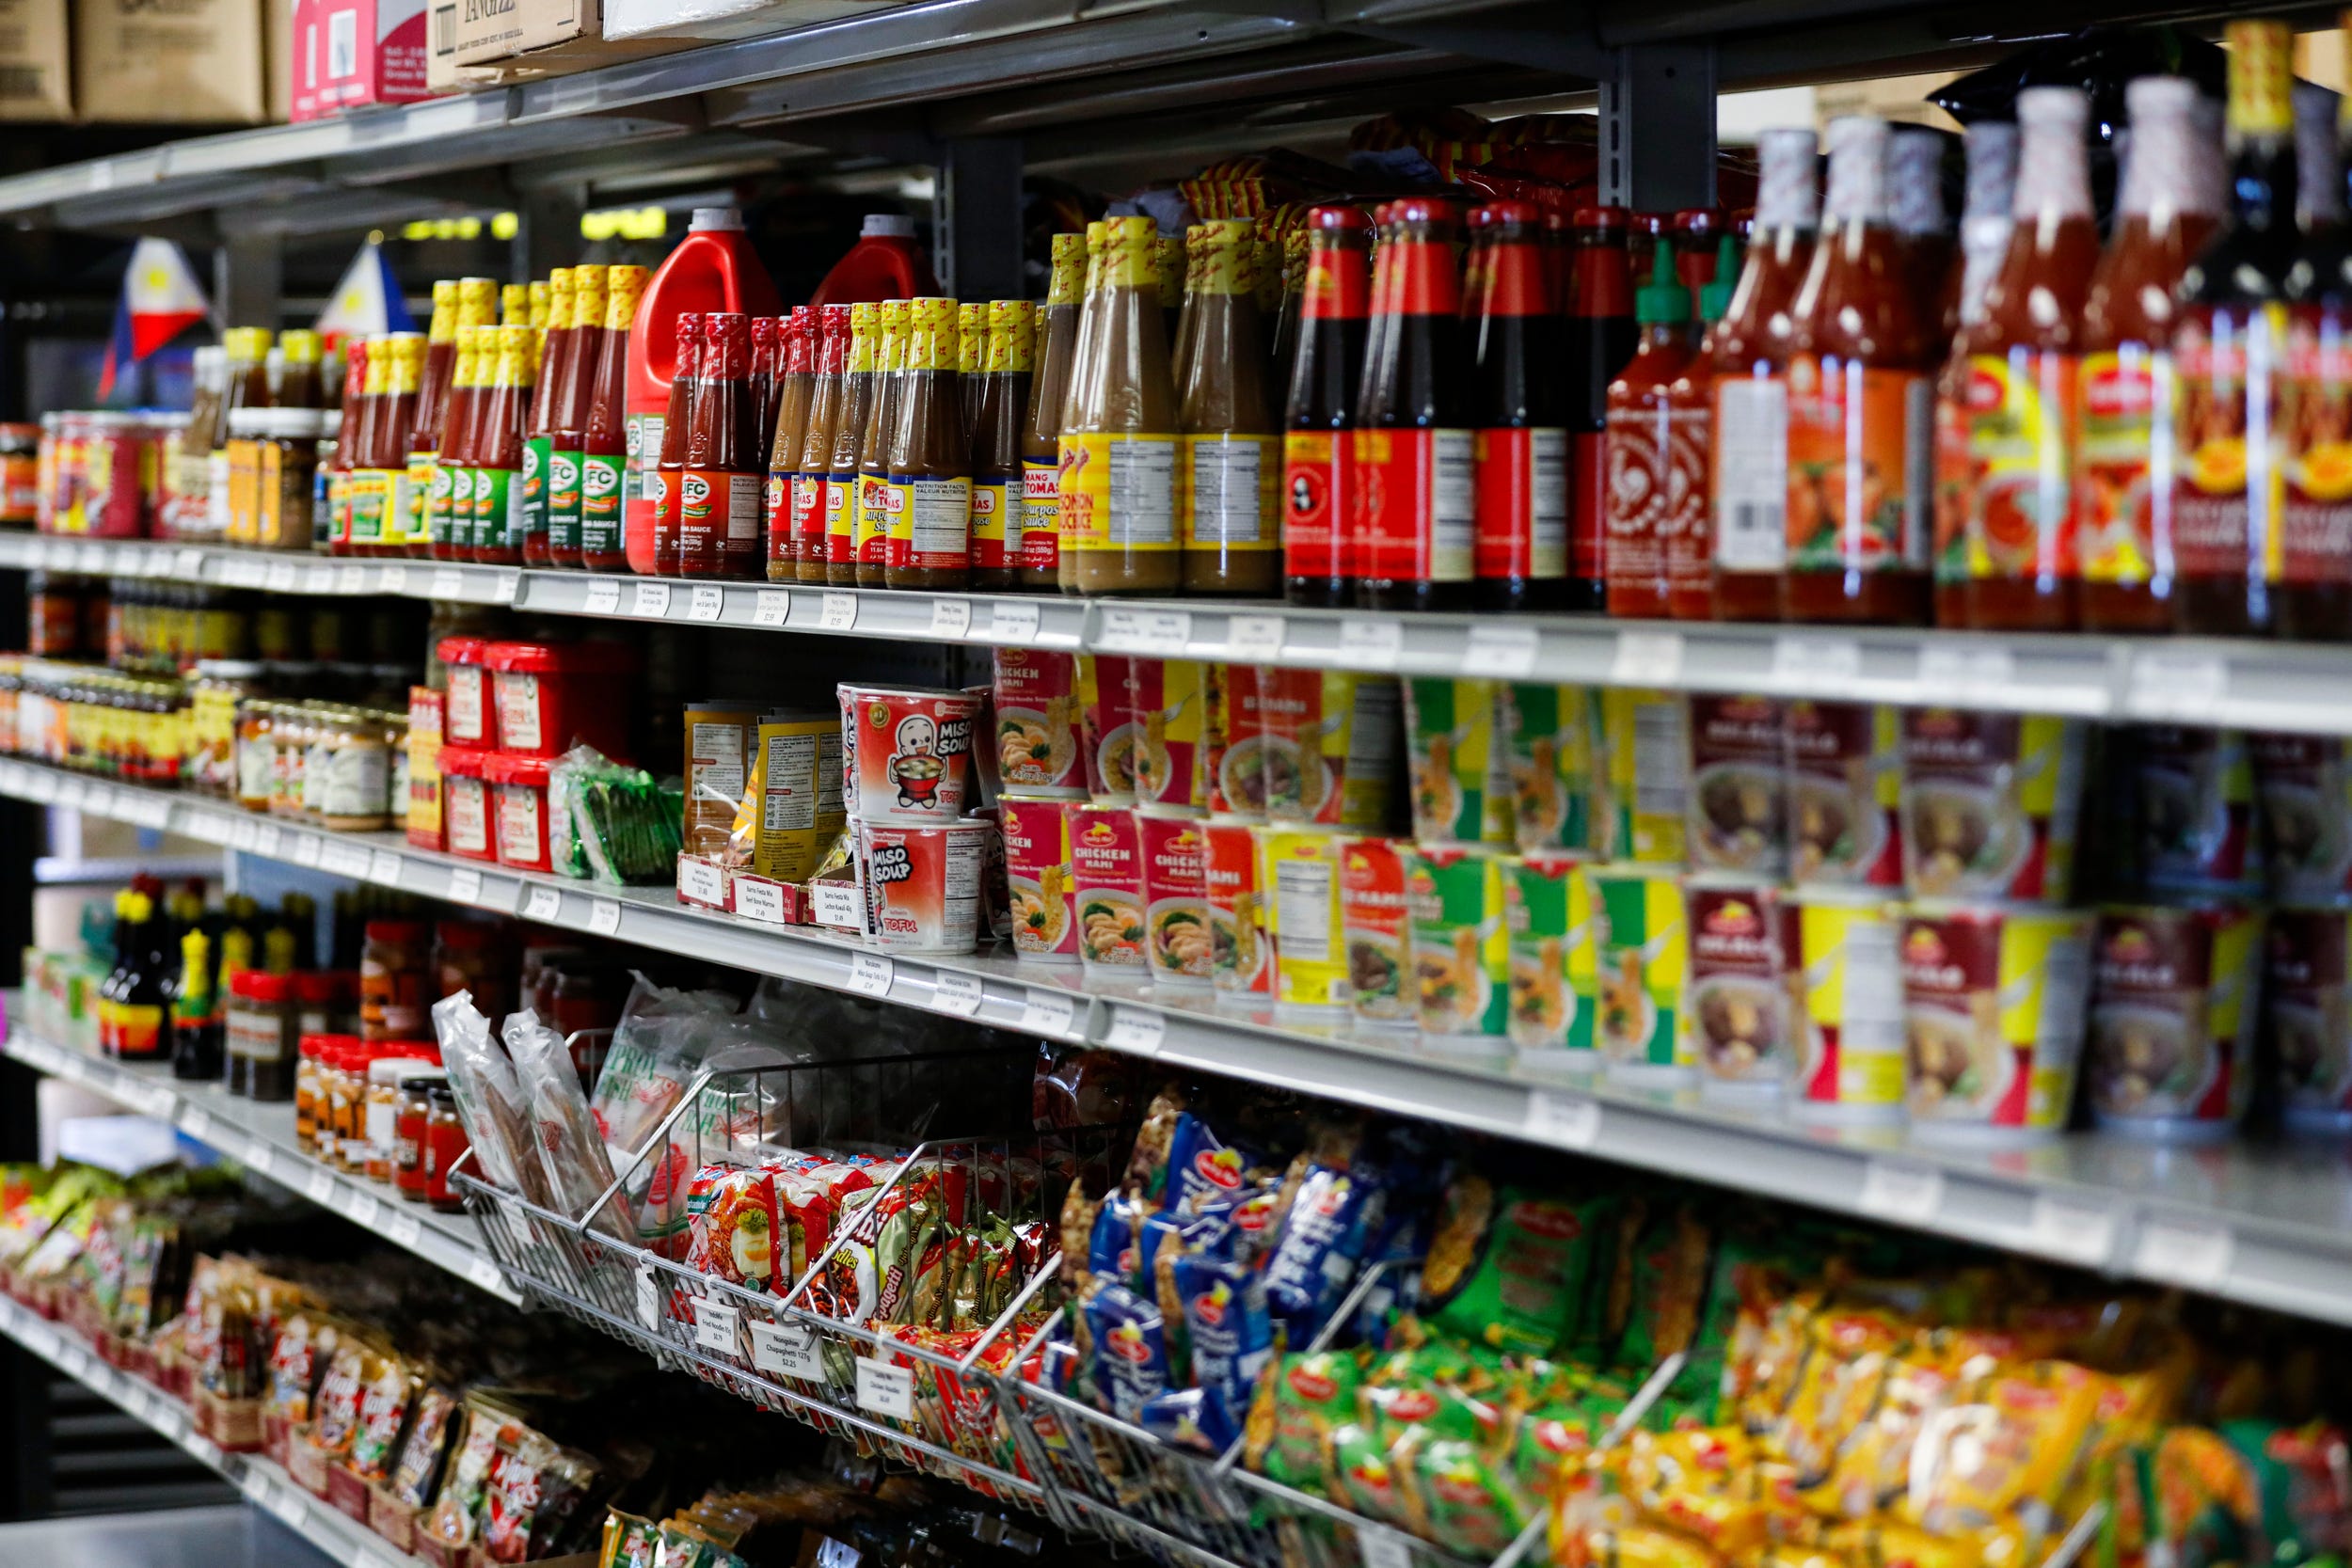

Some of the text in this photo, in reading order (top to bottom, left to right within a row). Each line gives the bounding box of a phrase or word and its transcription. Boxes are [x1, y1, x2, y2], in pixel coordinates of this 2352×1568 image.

[585, 471, 612, 484] FC
[1025, 473, 1048, 482] MANG
[972, 499, 989, 510] MAS
[865, 512, 887, 522] All-Pu
[941, 721, 971, 738] MISO
[938, 737, 970, 753] SOUP
[940, 791, 961, 803] TOF
[873, 847, 906, 865] MISO
[1074, 847, 1131, 861] CHICKEN
[1154, 854, 1206, 868] CHICK
[875, 863, 911, 881] SOUP
[818, 1241, 859, 1270] Nodles
[874, 1265, 905, 1321] pagetti
[773, 1335, 799, 1347] Nongshim
[782, 1358, 796, 1368] $2.25
[798, 1352, 811, 1362] 127g
